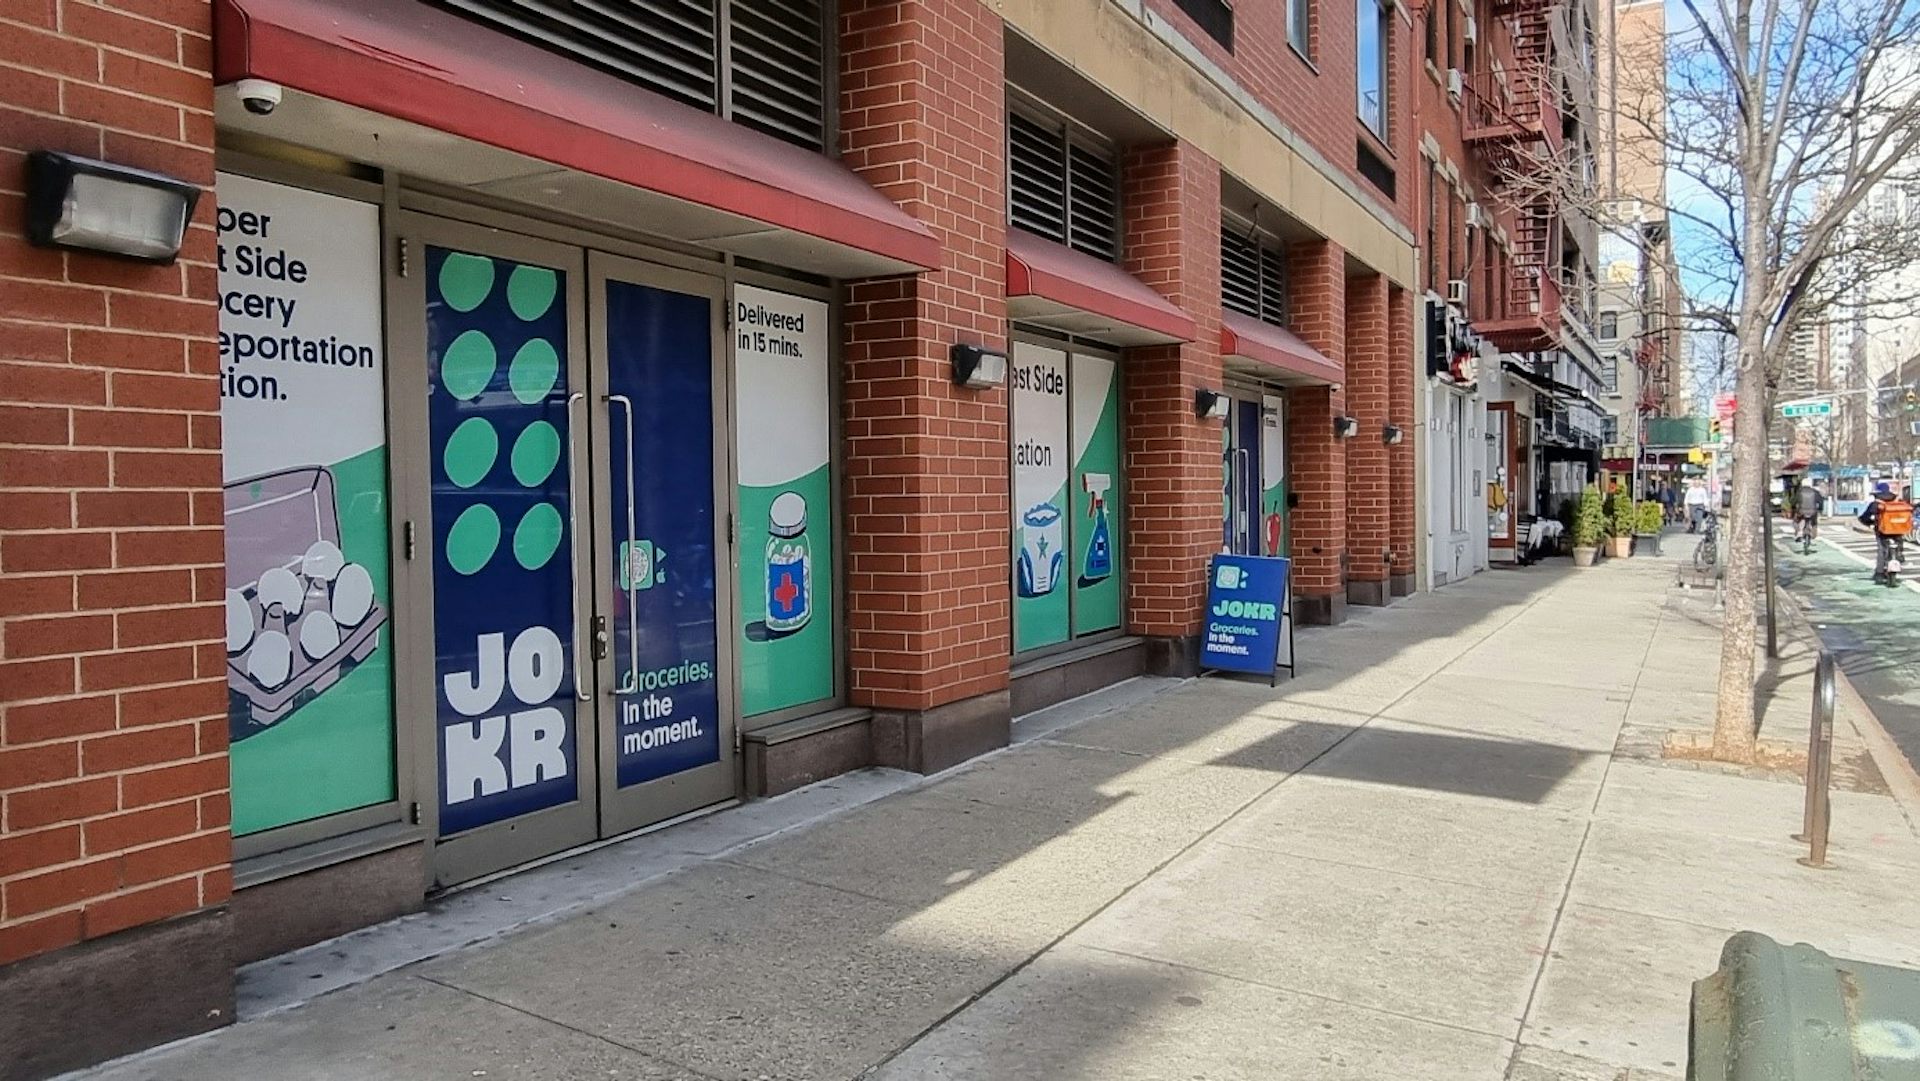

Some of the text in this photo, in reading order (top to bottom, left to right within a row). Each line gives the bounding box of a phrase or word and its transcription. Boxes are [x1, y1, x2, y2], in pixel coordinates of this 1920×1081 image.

[235, 245, 308, 283] Side
[218, 291, 296, 328] cery
[738, 302, 804, 333] Delivered
[738, 328, 803, 358] in 15 mins.
[1034, 364, 1063, 396] Side
[1212, 600, 1276, 620] JOKR
[1208, 632, 1235, 643] In the
[1210, 622, 1259, 635] Groceries.
[1207, 643, 1249, 655] moment.
[444, 625, 564, 716] JO
[623, 693, 673, 725] In the
[624, 716, 703, 755] moment.
[445, 706, 567, 805] KR
